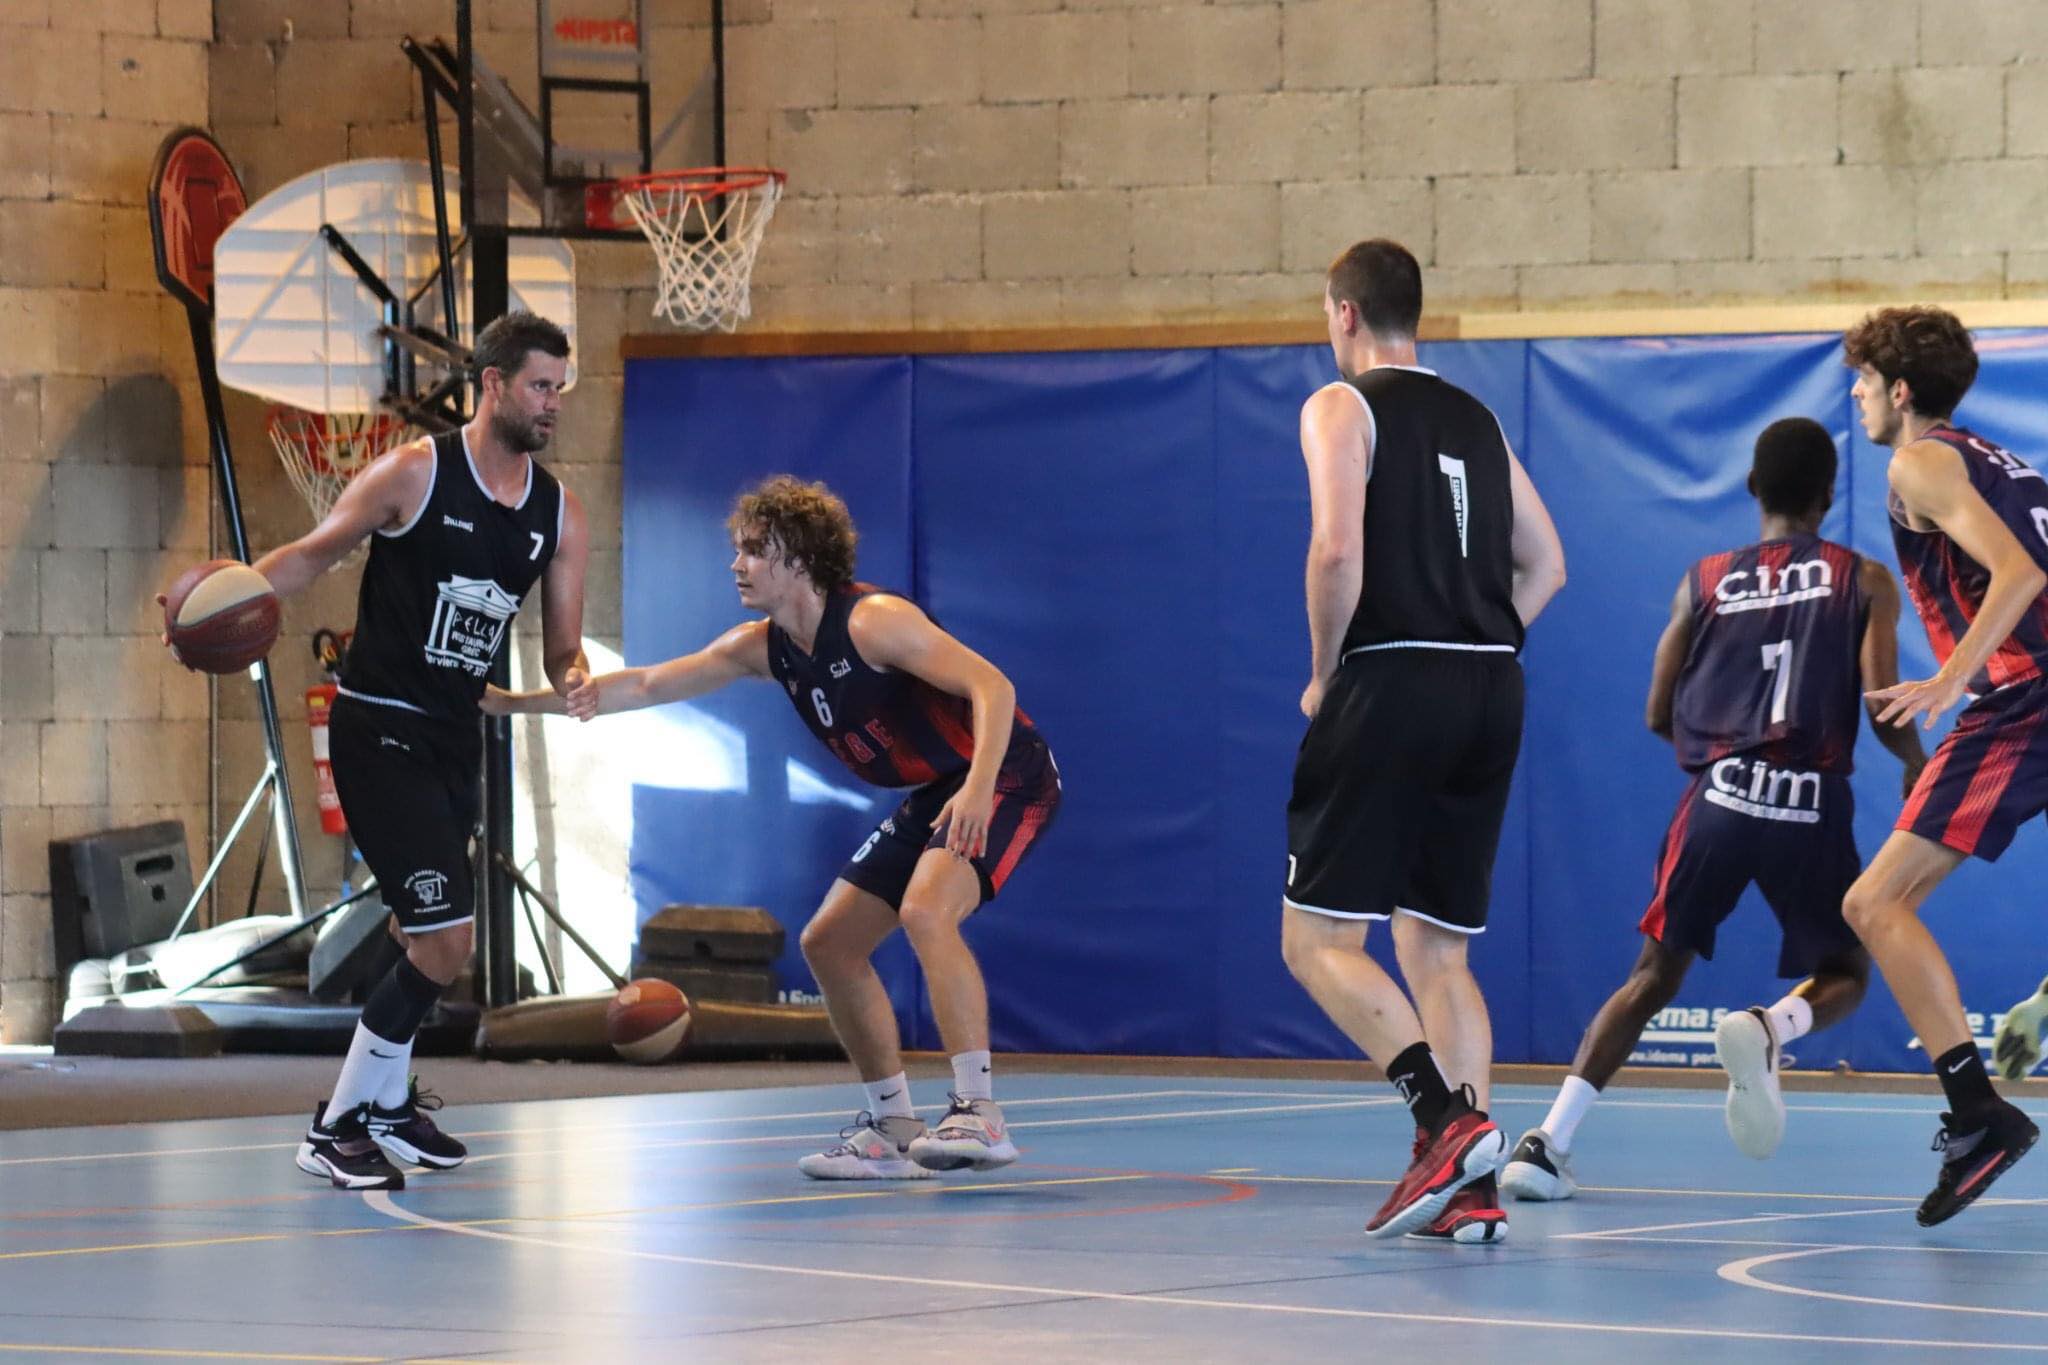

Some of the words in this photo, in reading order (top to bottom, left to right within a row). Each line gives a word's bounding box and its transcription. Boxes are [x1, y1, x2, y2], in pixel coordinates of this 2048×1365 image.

[529, 532, 545, 561] 7
[811, 687, 834, 728] 6
[851, 830, 881, 863] 6
